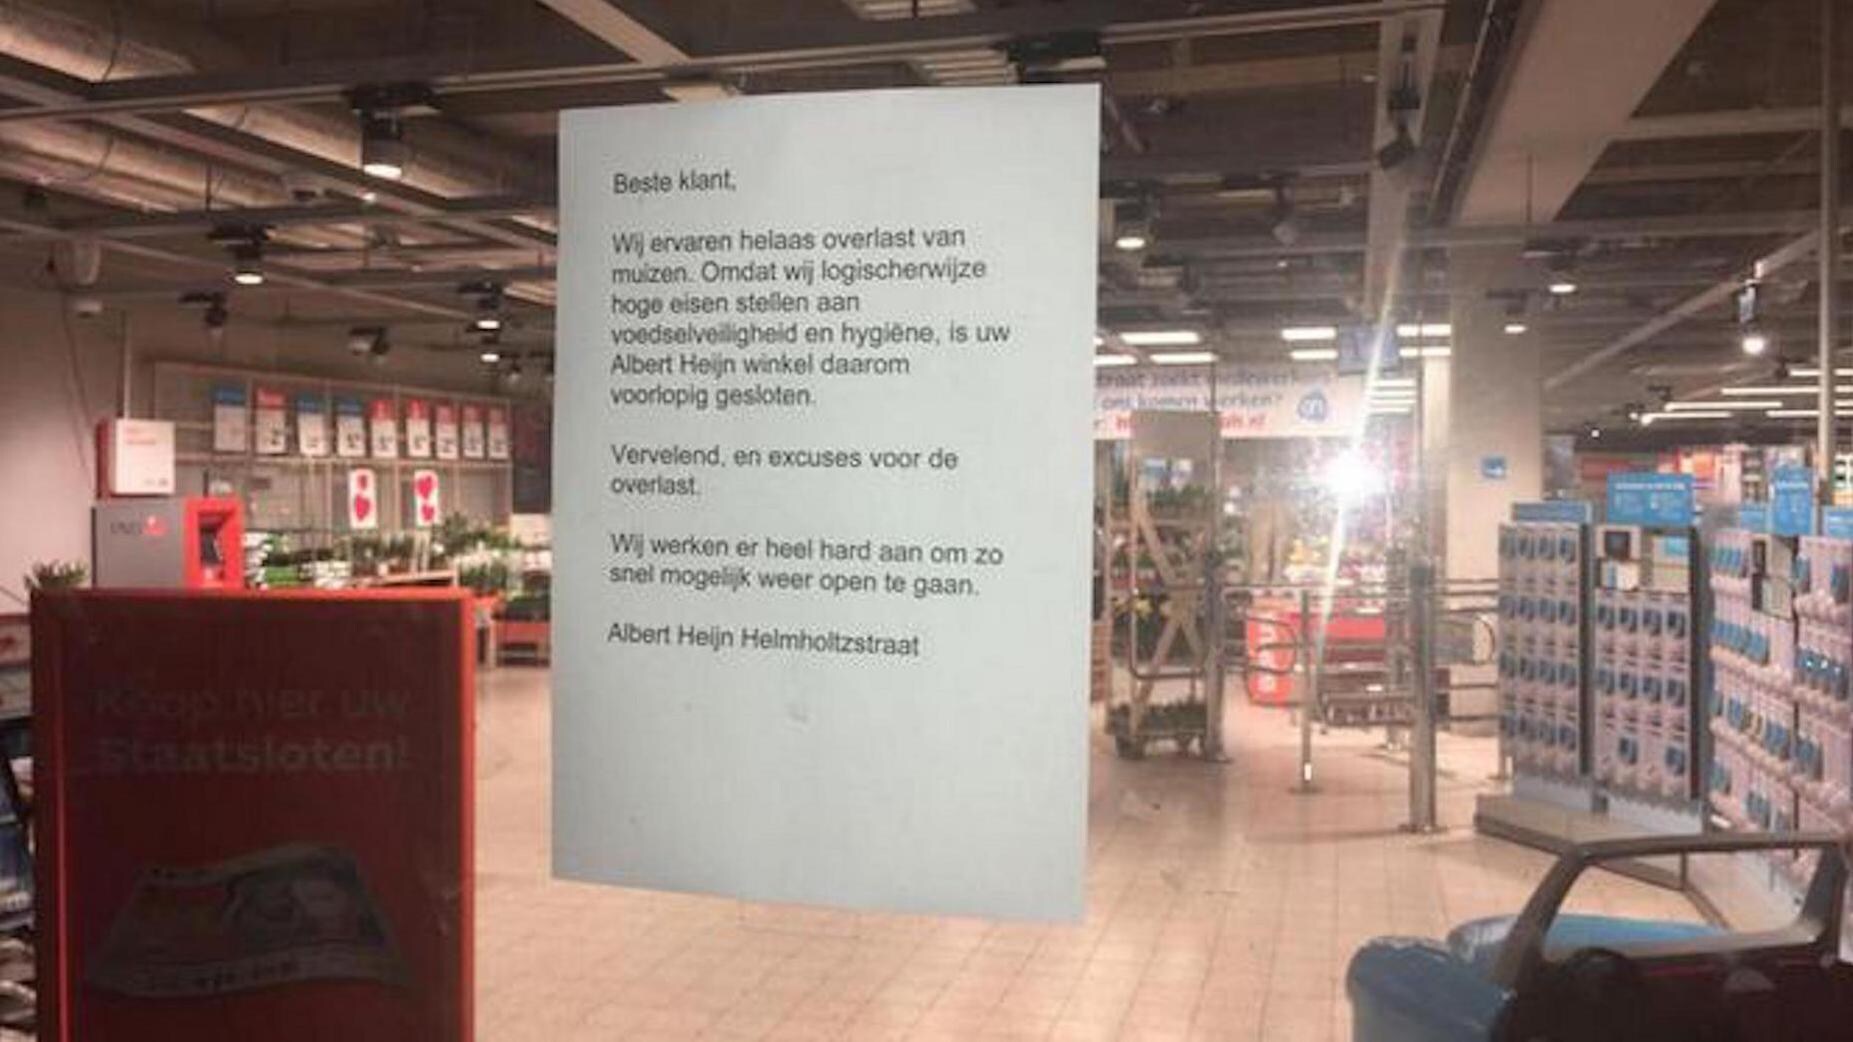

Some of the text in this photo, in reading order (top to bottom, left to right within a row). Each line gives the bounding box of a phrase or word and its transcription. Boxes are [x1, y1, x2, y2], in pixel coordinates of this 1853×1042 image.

[613, 169, 736, 194] Beste klant,
[612, 227, 965, 258] Wij ervaren helaas overlast van
[612, 258, 987, 286] muizen. Omdat wij logischerwijze
[612, 292, 860, 319] hoge eisen stellen aan
[611, 322, 1011, 348] voedselveiligheid en hygiëne, is uw
[611, 353, 910, 379] Albert Heijn winkel daarom
[610, 384, 816, 411] voorlopig gesloten.
[611, 444, 959, 470] Vervelend, en excuses voor de
[611, 475, 701, 496] overlast.
[610, 533, 1004, 565] Wij werken er heel hard aan om zo
[609, 564, 979, 599] snel mogelijk weer open te gaan.
[608, 622, 919, 657] Albert Heijn Helmholtzstraat
[97, 734, 411, 774] Staatsloten!
